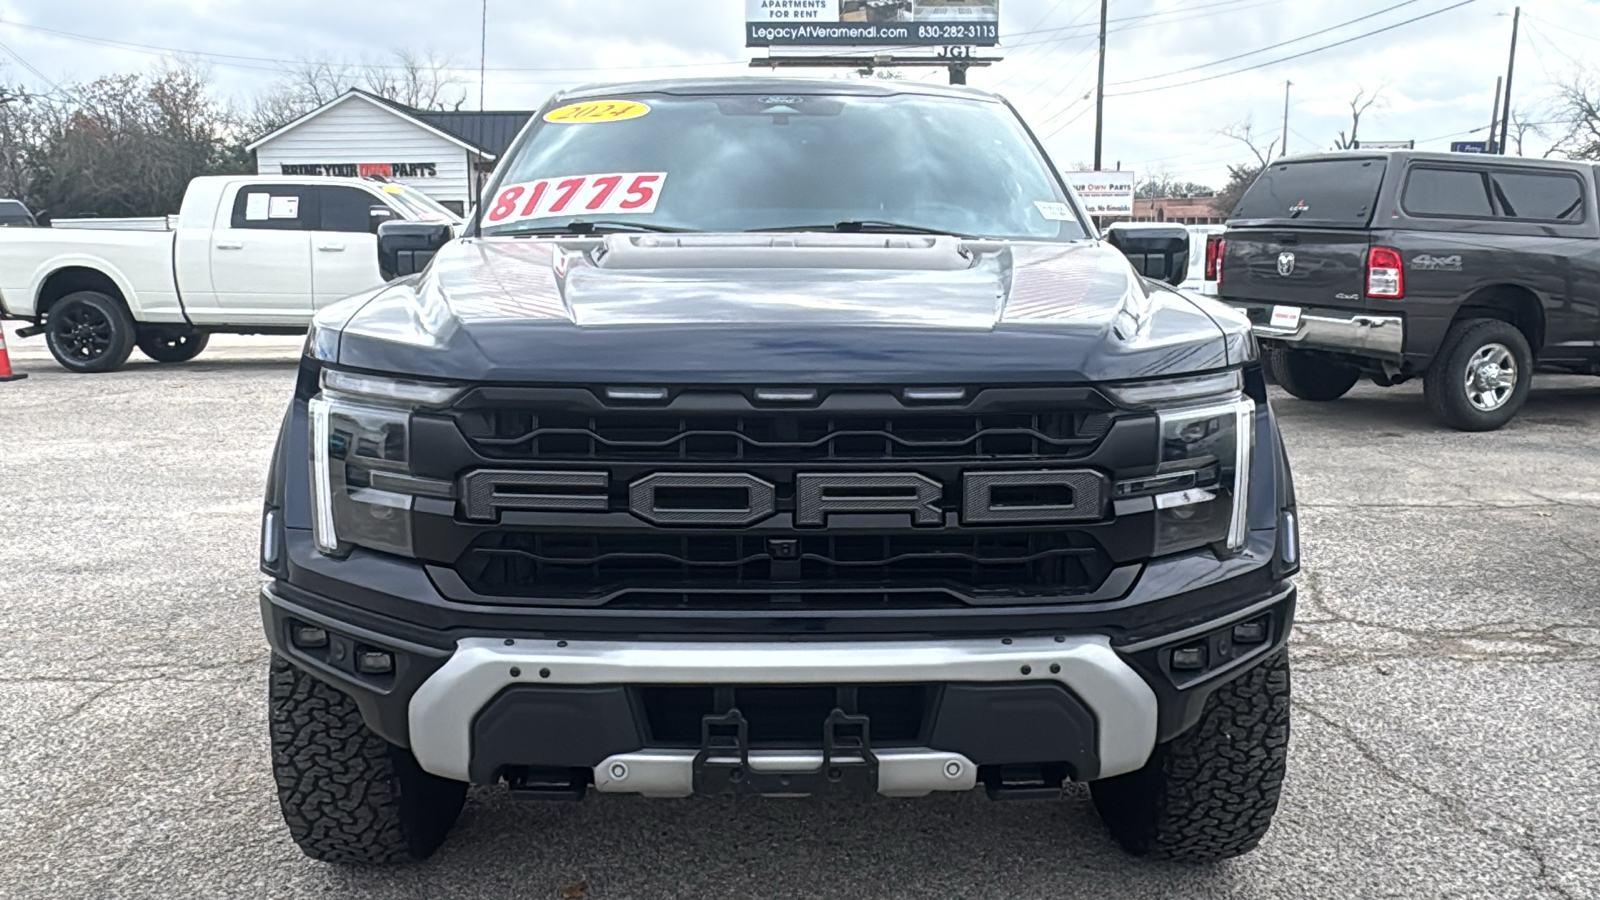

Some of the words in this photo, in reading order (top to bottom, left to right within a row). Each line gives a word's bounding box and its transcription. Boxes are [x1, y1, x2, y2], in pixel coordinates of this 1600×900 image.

[761, 0, 826, 8] APARTMENTS
[769, 10, 790, 18] FOR
[793, 10, 818, 18] RENT
[752, 26, 908, 40] LegacyAtVeramendi.com
[918, 25, 996, 38] 830-282-3113
[937, 45, 971, 58] JGI
[555, 104, 636, 120] 2024
[281, 164, 323, 176] BRING
[323, 163, 359, 177] YOUR
[392, 163, 437, 177] PARTS
[1109, 183, 1132, 191] PARTS
[489, 175, 660, 221] 81775
[1411, 254, 1463, 267] 4x4
[463, 468, 1108, 527] FORD
